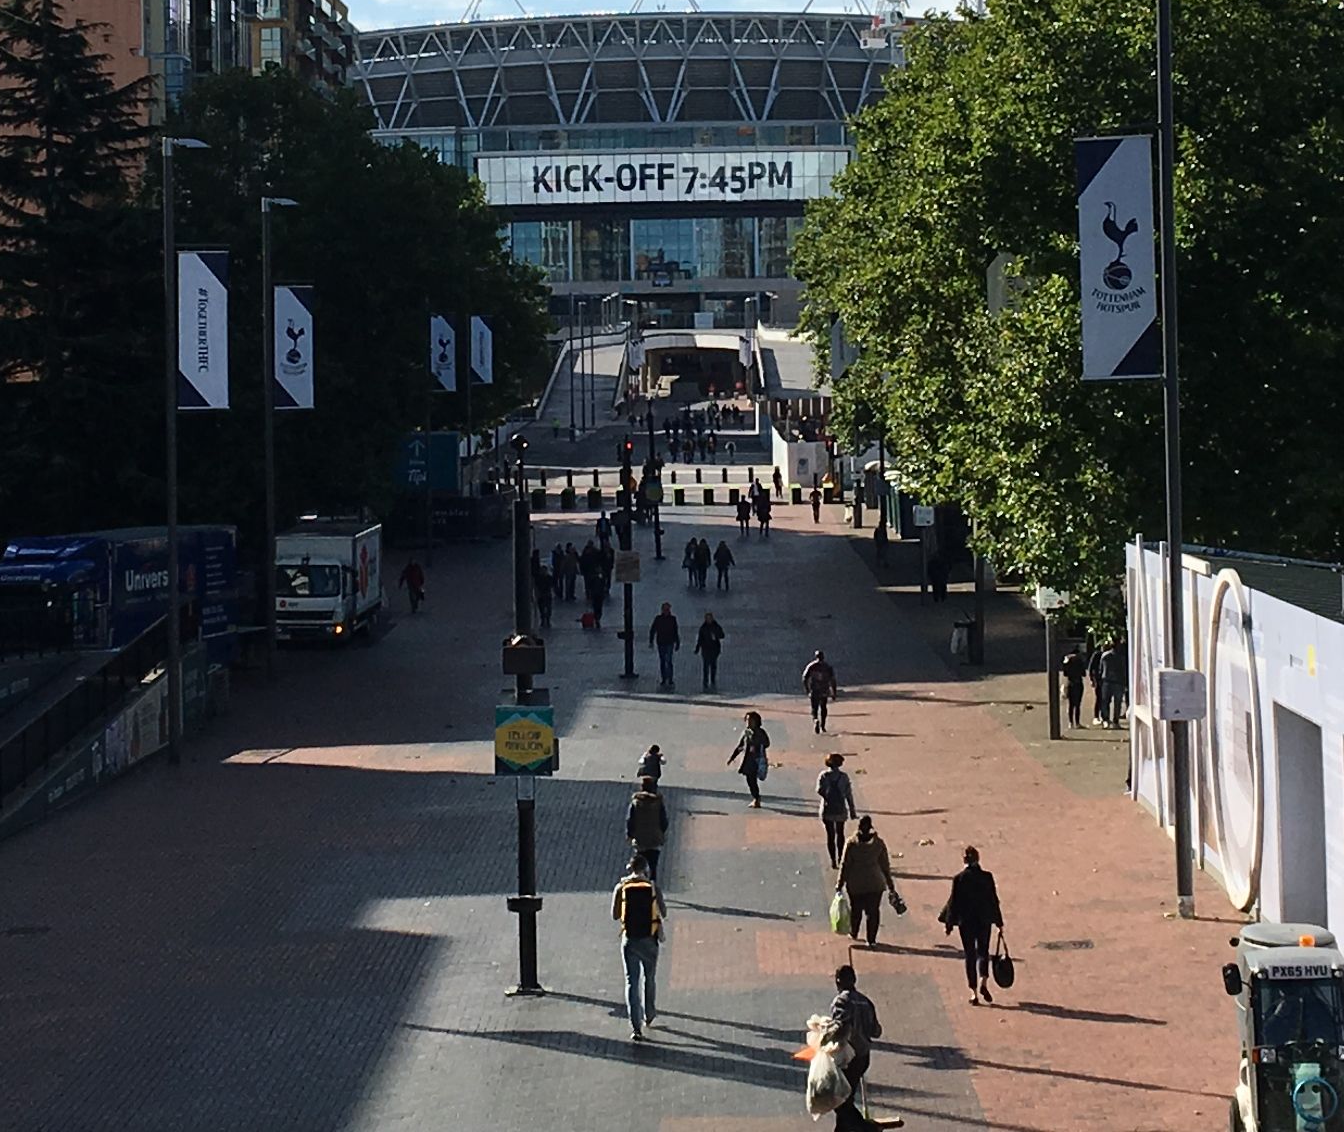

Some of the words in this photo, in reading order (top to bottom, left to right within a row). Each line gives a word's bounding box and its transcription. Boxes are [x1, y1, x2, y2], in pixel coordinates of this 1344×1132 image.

[533, 163, 675, 193] KICK-OFF
[683, 161, 793, 194] 7:45PM
[1091, 286, 1146, 304] TOTTENHAM
[1096, 301, 1140, 314] HOTSPUR
[125, 568, 176, 592] Univers
[1272, 966, 1302, 977] PX65
[1305, 965, 1329, 976] HVU
